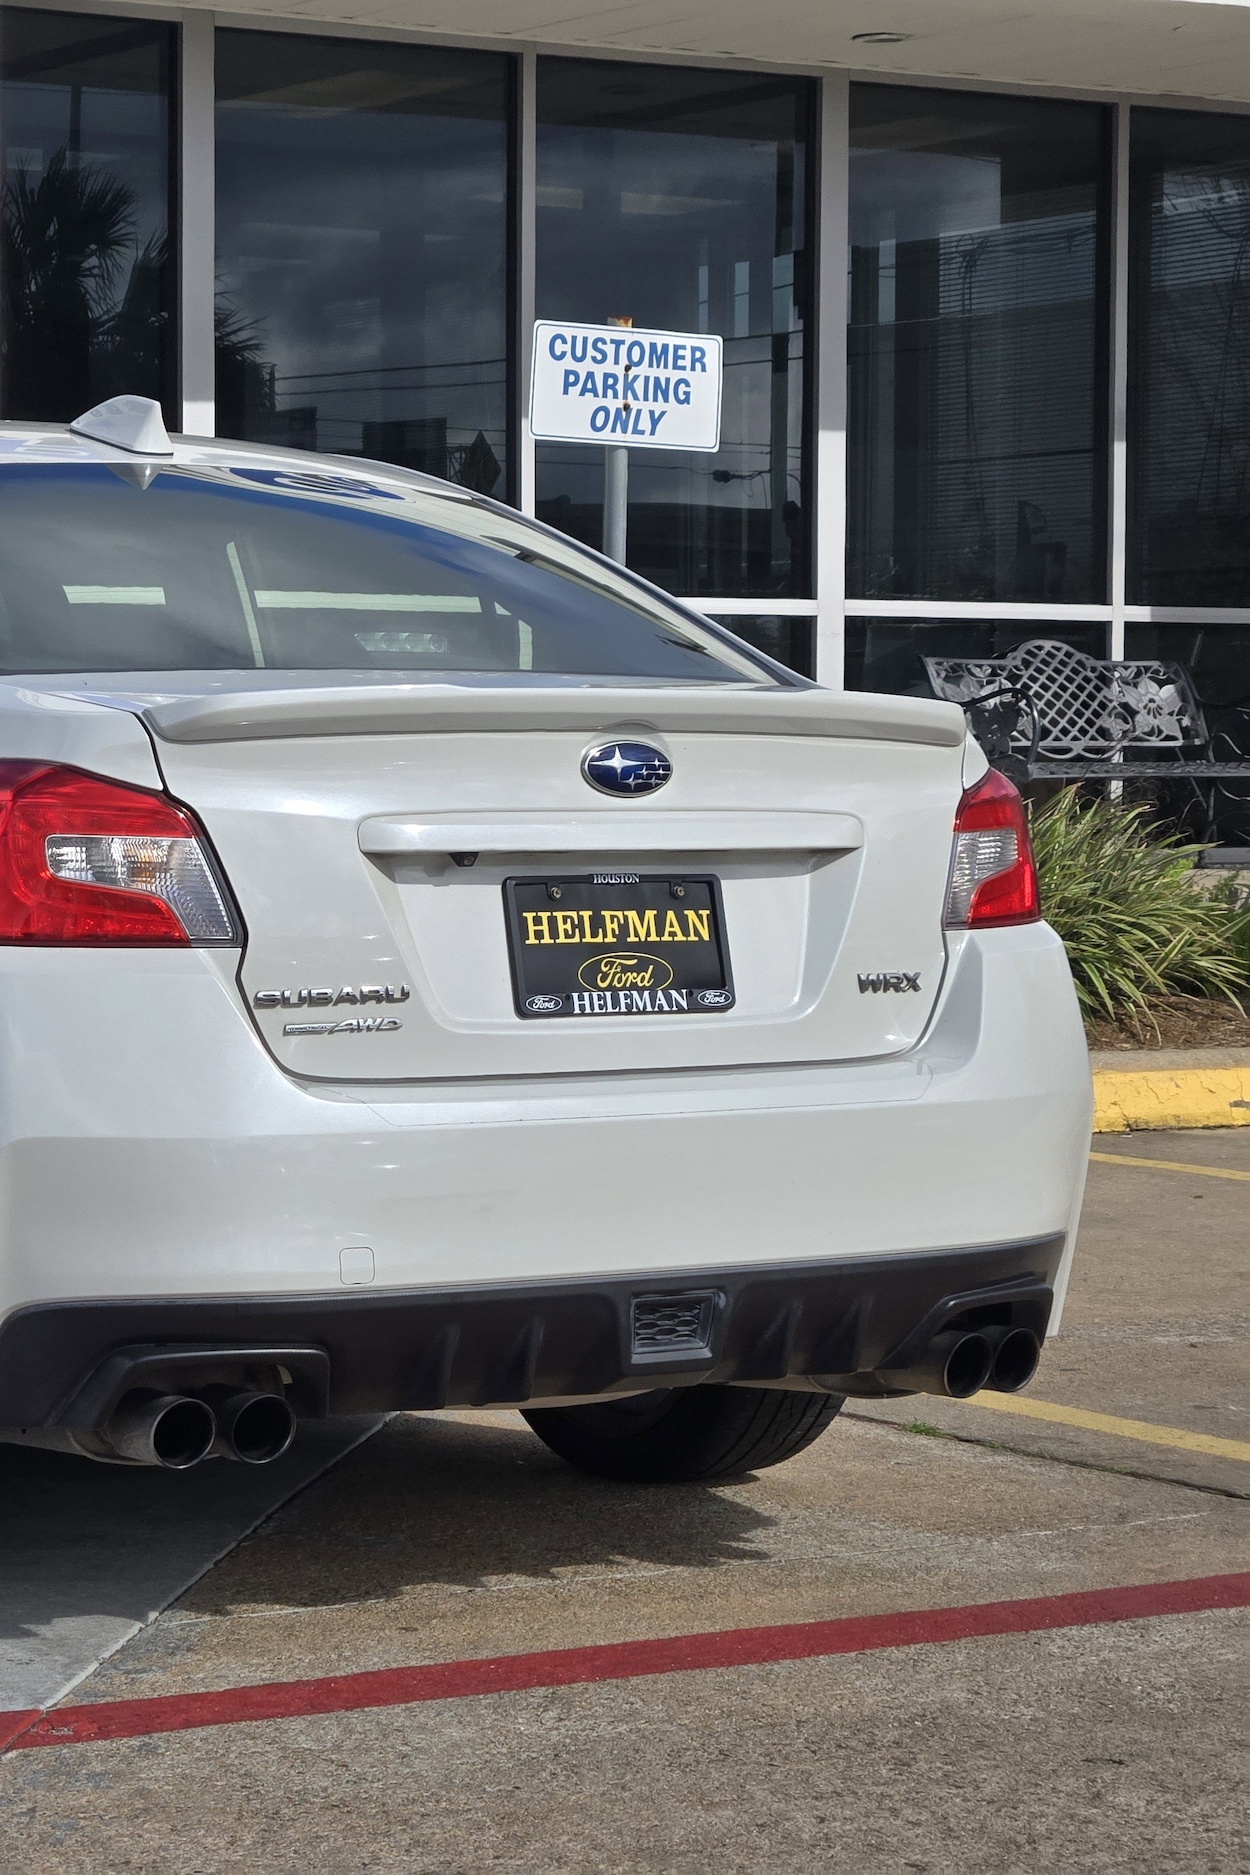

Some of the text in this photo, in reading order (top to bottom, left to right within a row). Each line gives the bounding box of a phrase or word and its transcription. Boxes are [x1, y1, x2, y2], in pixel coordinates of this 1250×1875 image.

[548, 333, 707, 373] CUSTOMER
[562, 369, 691, 405] PARKING
[590, 405, 668, 436] ONLY
[593, 874, 640, 884] HOUSTON
[523, 909, 711, 944] HELFMAN
[597, 957, 655, 988] Ford
[857, 972, 922, 994] WRX
[253, 984, 411, 1010] SUBARU
[532, 997, 556, 1009] Ford
[571, 989, 689, 1014] HELFMAN
[703, 992, 727, 1004] Ford
[328, 1017, 403, 1035] AWD
